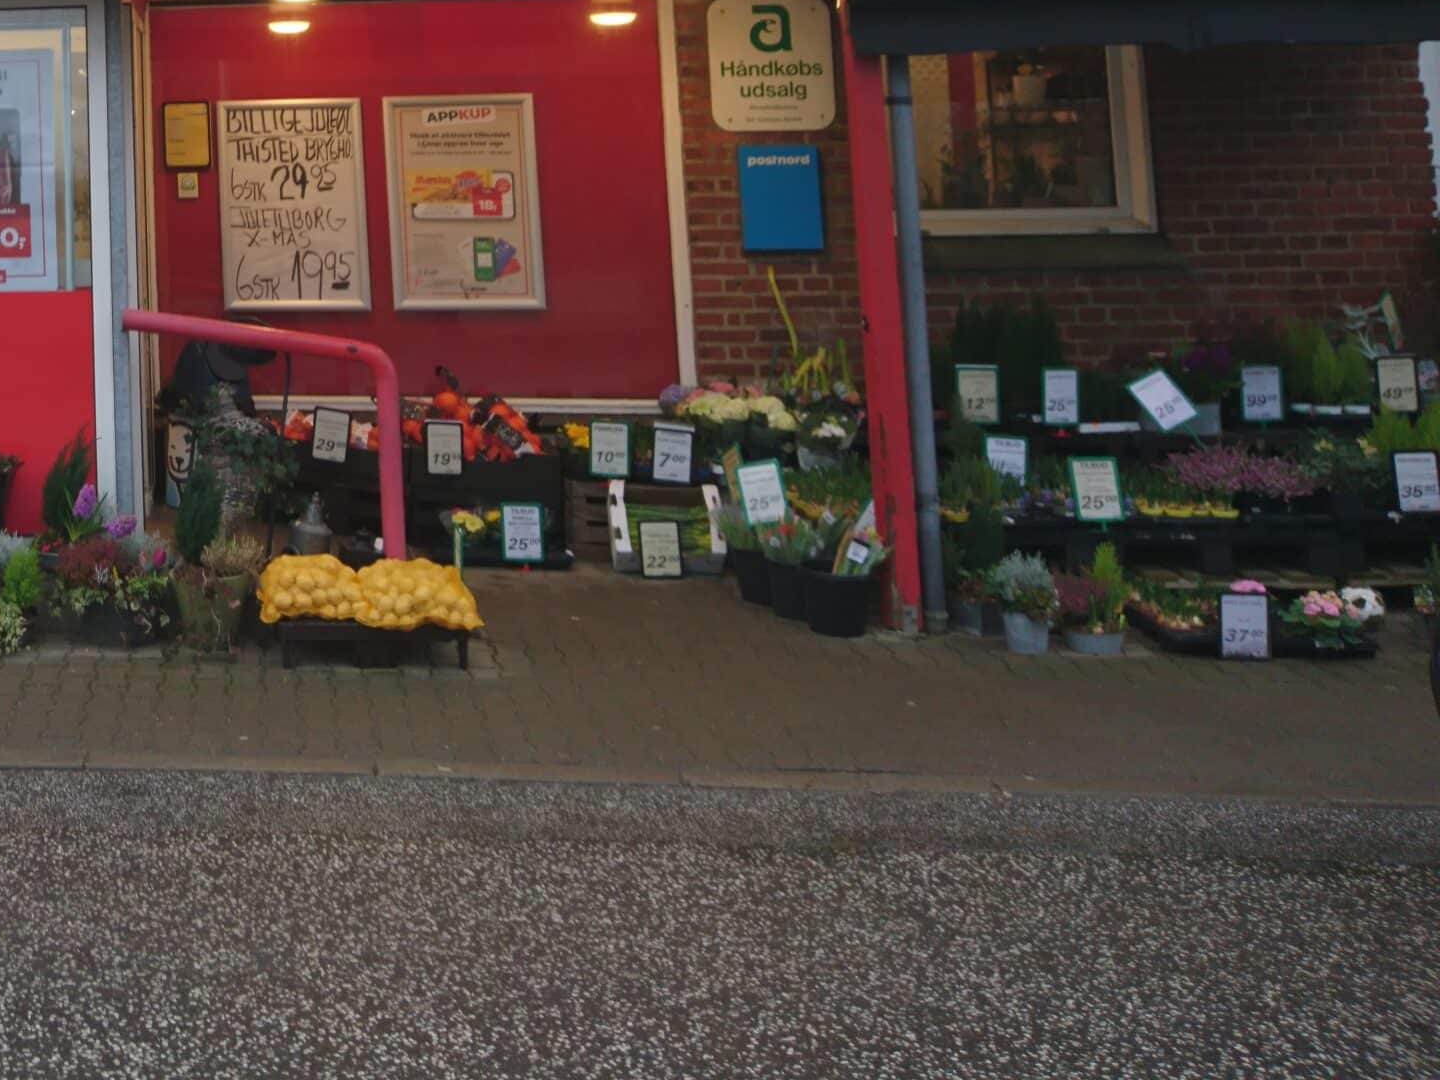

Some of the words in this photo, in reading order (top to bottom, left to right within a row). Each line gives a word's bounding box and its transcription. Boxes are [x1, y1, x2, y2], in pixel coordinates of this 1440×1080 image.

[720, 59, 824, 78] Håndkøbs
[740, 80, 808, 101] udsalg
[226, 107, 304, 135] BILLIGE
[427, 107, 491, 123] APPKUP
[227, 136, 300, 164] THISTED
[747, 154, 810, 168] postnord
[270, 162, 309, 201] 29
[244, 229, 312, 250] X-MAS
[315, 437, 336, 452] 29
[432, 452, 450, 466] 19
[596, 450, 615, 463] 10
[658, 451, 672, 468] 7
[1081, 495, 1104, 510] 25
[508, 536, 529, 551] 25
[646, 554, 667, 569] 22
